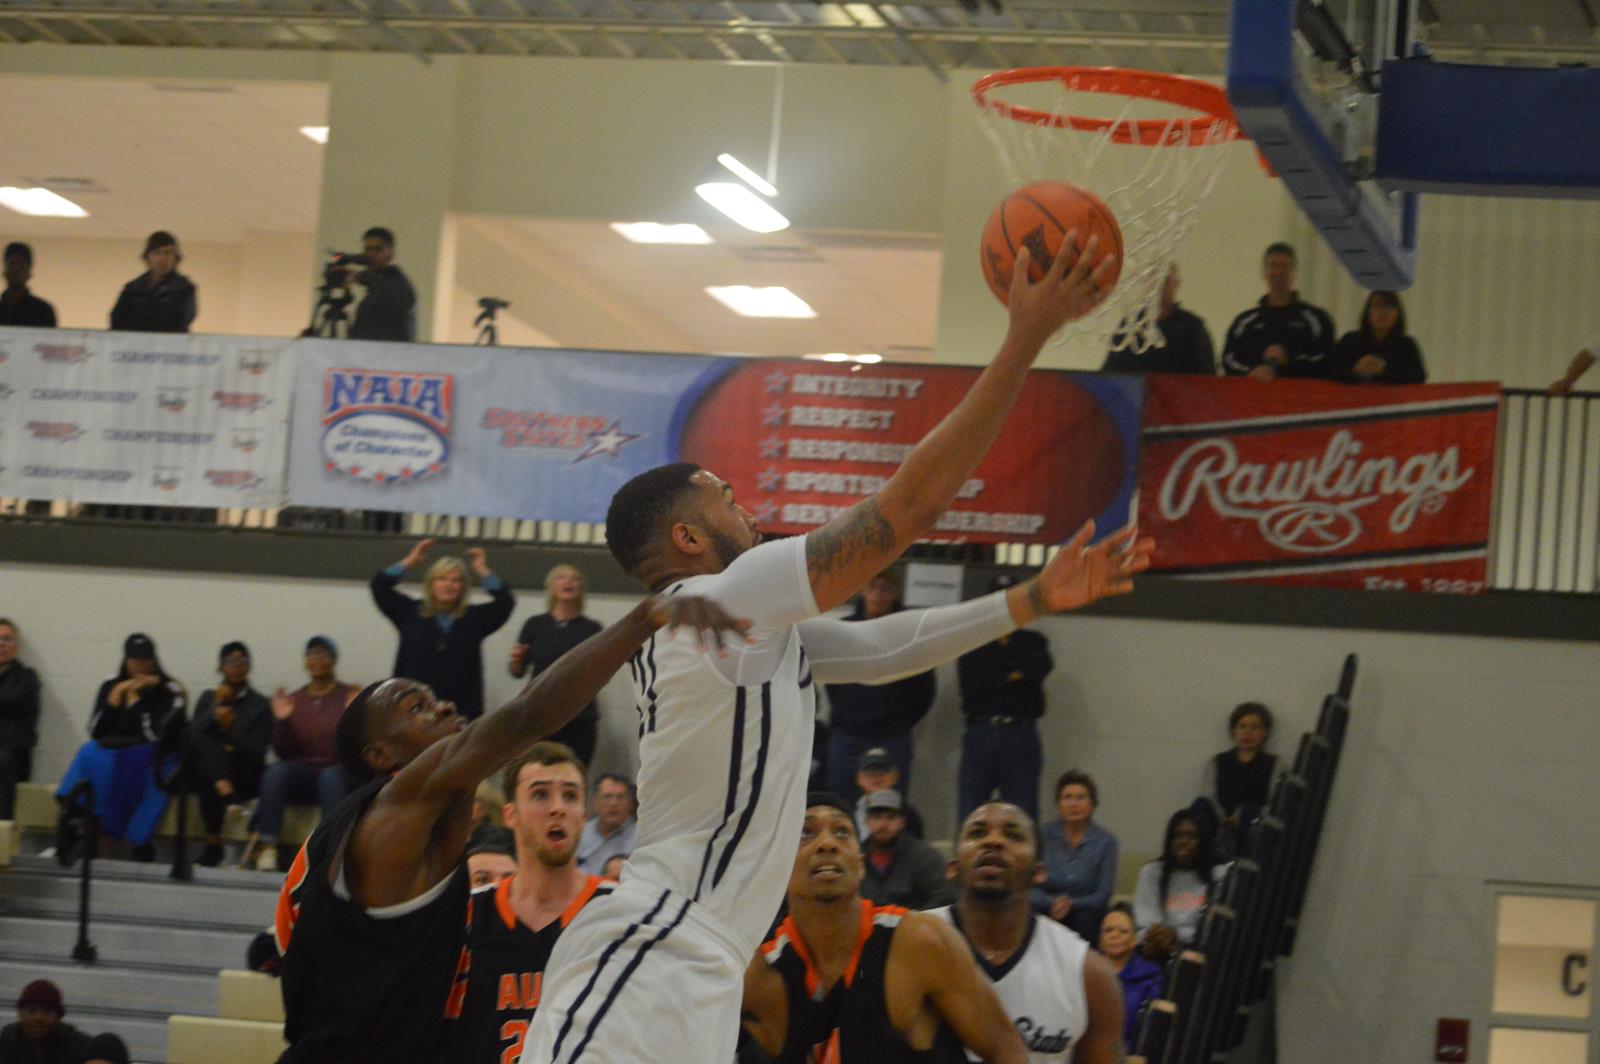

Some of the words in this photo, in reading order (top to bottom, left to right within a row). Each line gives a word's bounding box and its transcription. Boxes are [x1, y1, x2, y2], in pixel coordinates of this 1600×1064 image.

[328, 372, 443, 420] NAIA
[792, 374, 924, 399] INTEGRITY
[789, 405, 895, 431] RESPECT
[1159, 430, 1474, 534] Rawlings
[1561, 953, 1588, 997] C
